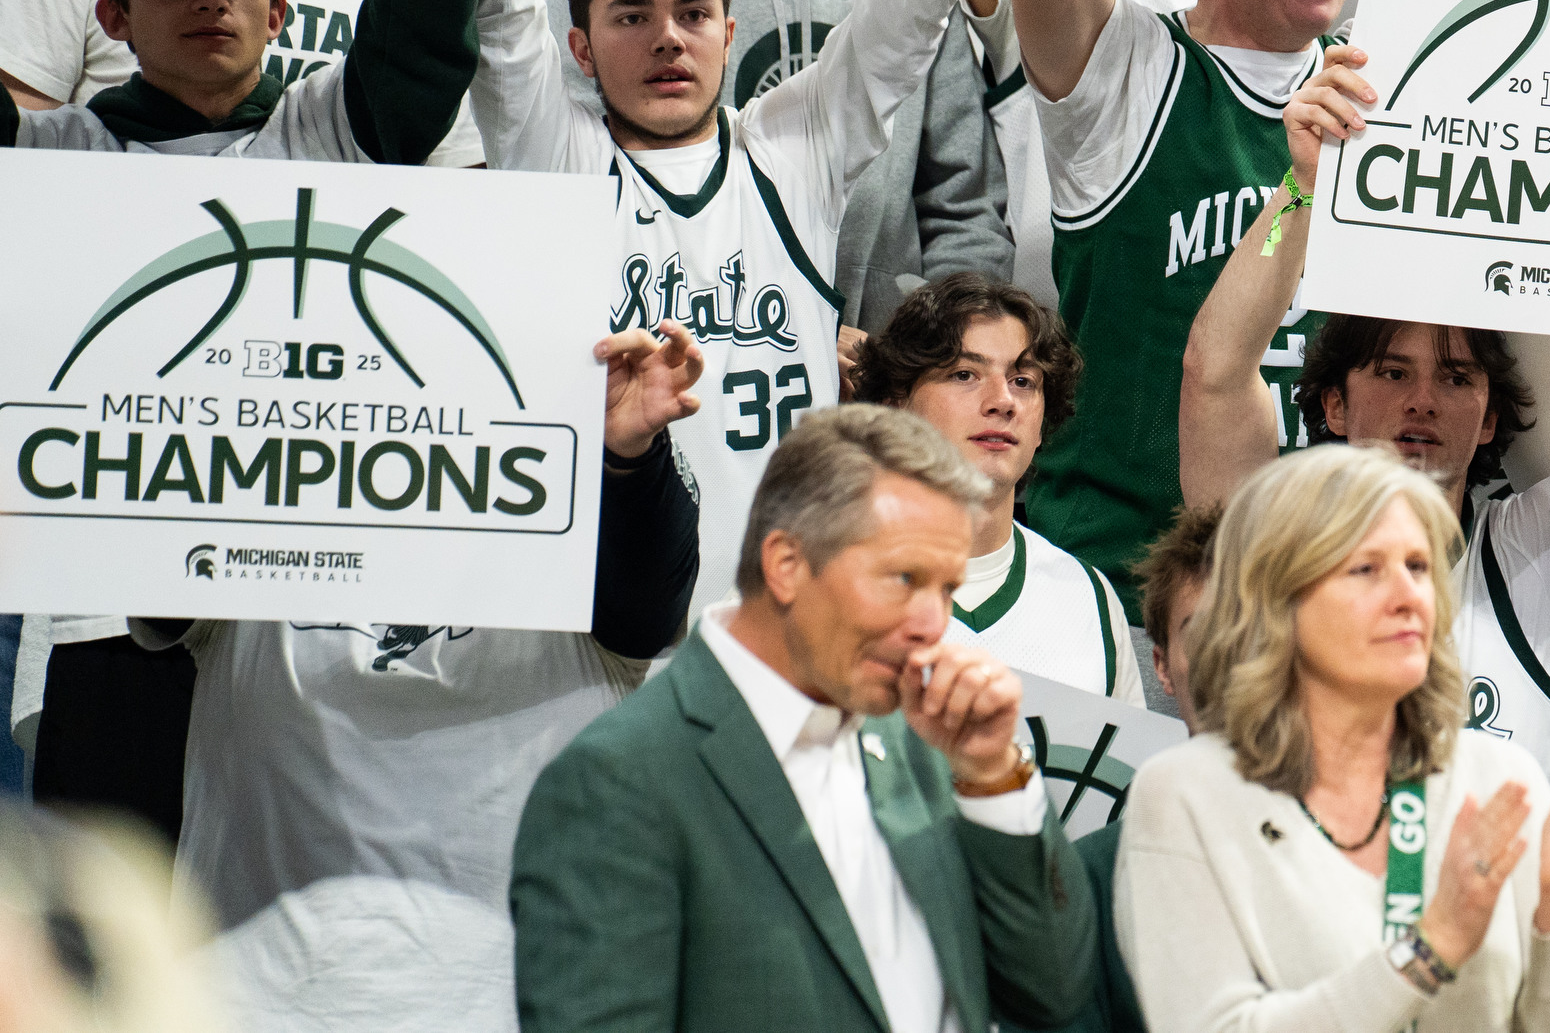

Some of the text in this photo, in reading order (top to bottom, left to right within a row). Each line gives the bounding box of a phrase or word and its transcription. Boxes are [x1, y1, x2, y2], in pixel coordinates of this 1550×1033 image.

[1508, 78, 1532, 95] 20
[1421, 114, 1520, 152] MEN'S
[609, 249, 799, 352] State
[205, 348, 232, 366] 20
[357, 353, 382, 372] 25
[101, 393, 474, 436] MEN'S BASKETBALL
[722, 363, 813, 452] 32
[17, 426, 548, 516] CHAMPIONS
[225, 548, 364, 569] MICHIGAN STATE
[225, 569, 363, 583] BASKETBALL
[1389, 791, 1427, 854] GO
